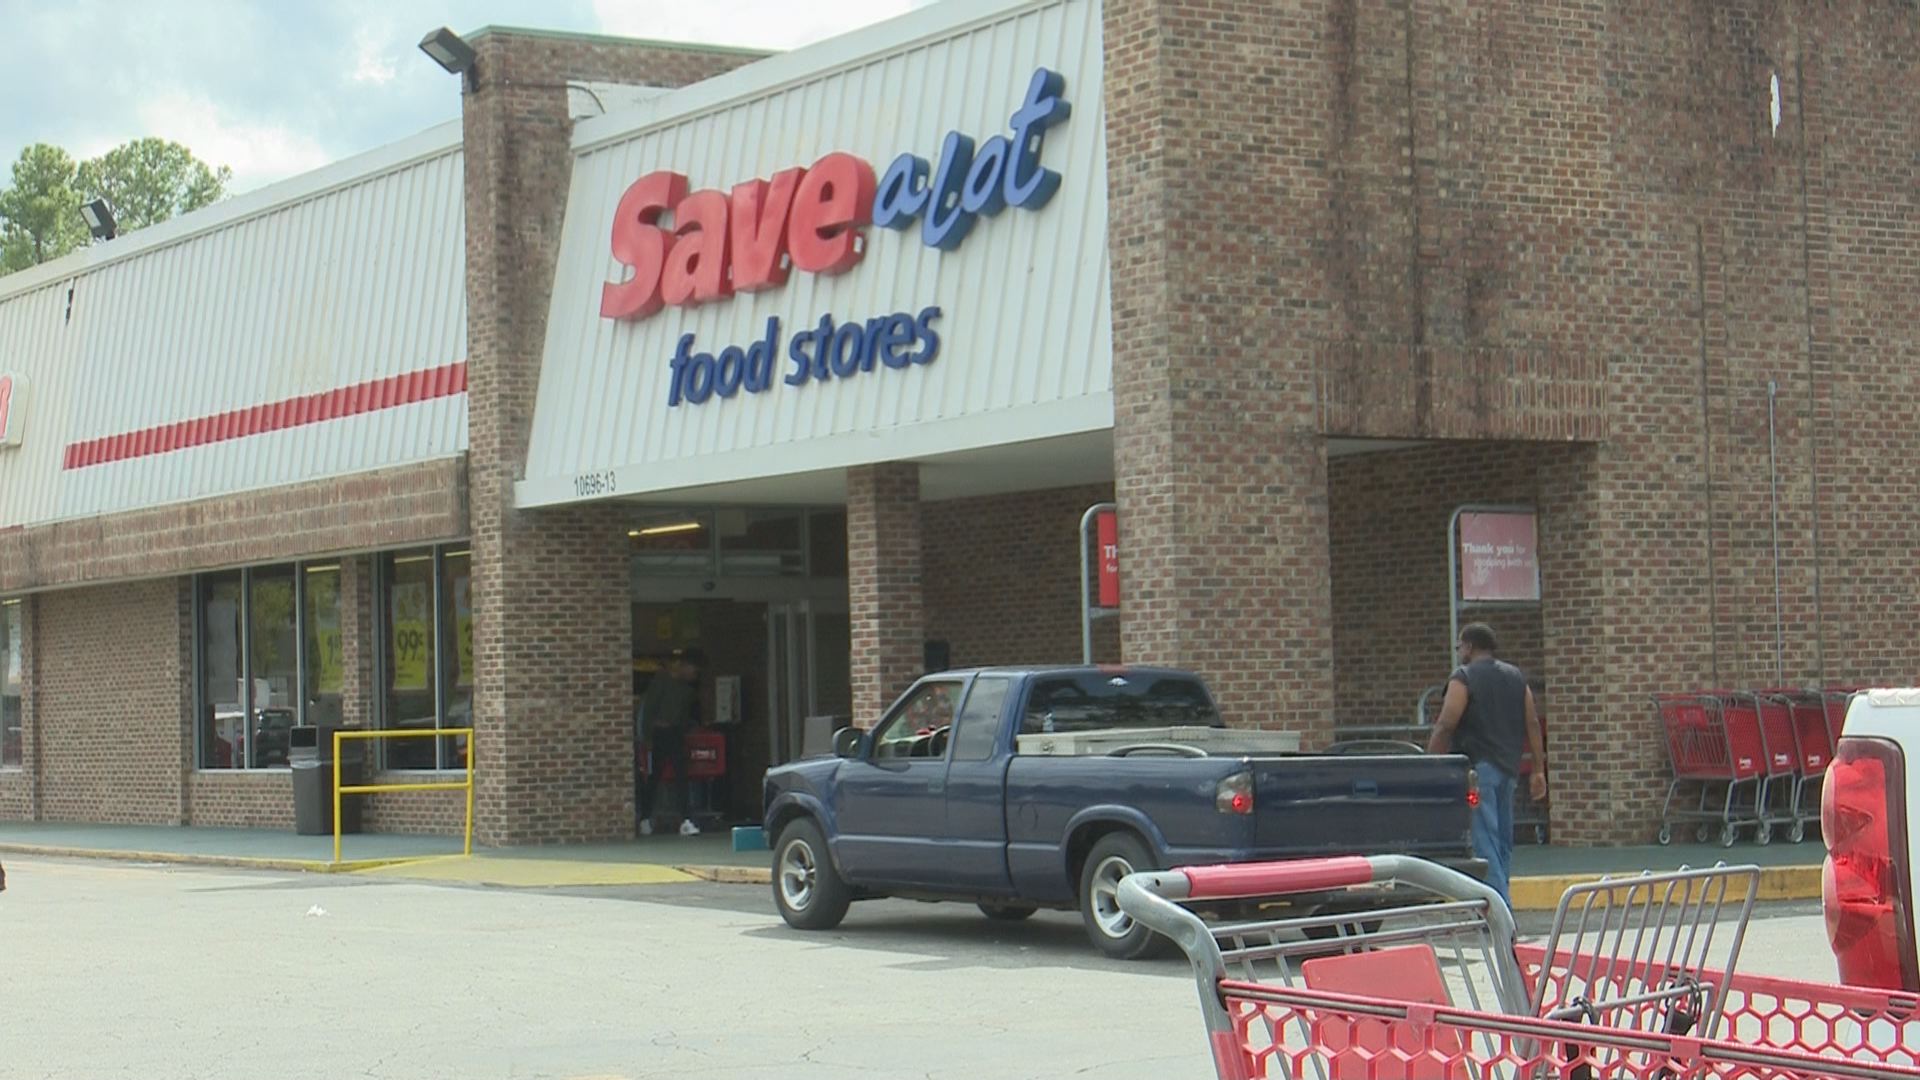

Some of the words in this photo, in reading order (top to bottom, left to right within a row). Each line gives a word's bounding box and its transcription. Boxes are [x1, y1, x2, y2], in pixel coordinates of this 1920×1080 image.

[600, 151, 877, 321] Save
[668, 315, 780, 407] food
[784, 306, 942, 386] stores
[574, 470, 616, 496] 10696-13
[1462, 542, 1494, 554] Thank
[1496, 545, 1514, 556] you
